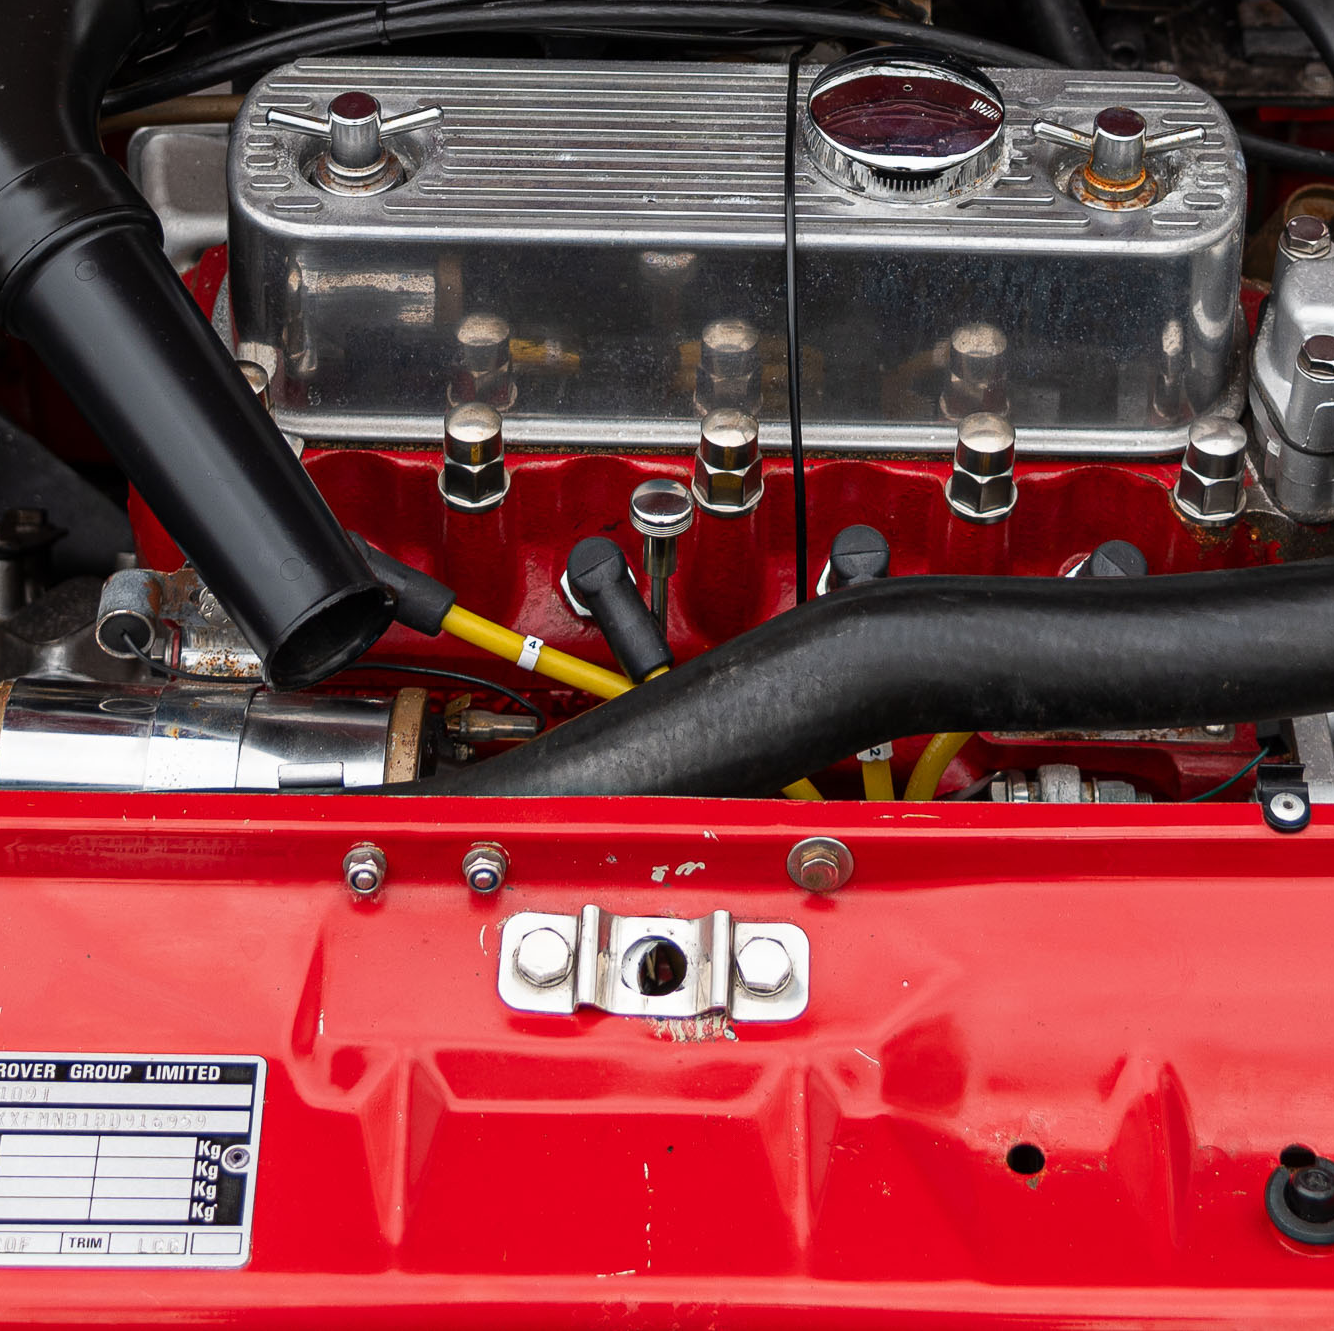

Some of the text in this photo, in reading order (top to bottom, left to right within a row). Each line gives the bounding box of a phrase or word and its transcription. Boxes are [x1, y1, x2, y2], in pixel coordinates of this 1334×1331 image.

[528, 640, 537, 649] 4
[870, 748, 880, 757] 2
[69, 1063, 132, 1081] GROUP
[145, 1064, 221, 1081] LIMITED
[197, 1139, 222, 1160] Kg
[195, 1160, 219, 1180] Kg
[193, 1181, 217, 1201] Kg
[191, 1202, 216, 1222] Kg
[68, 1236, 103, 1250] TRIM
